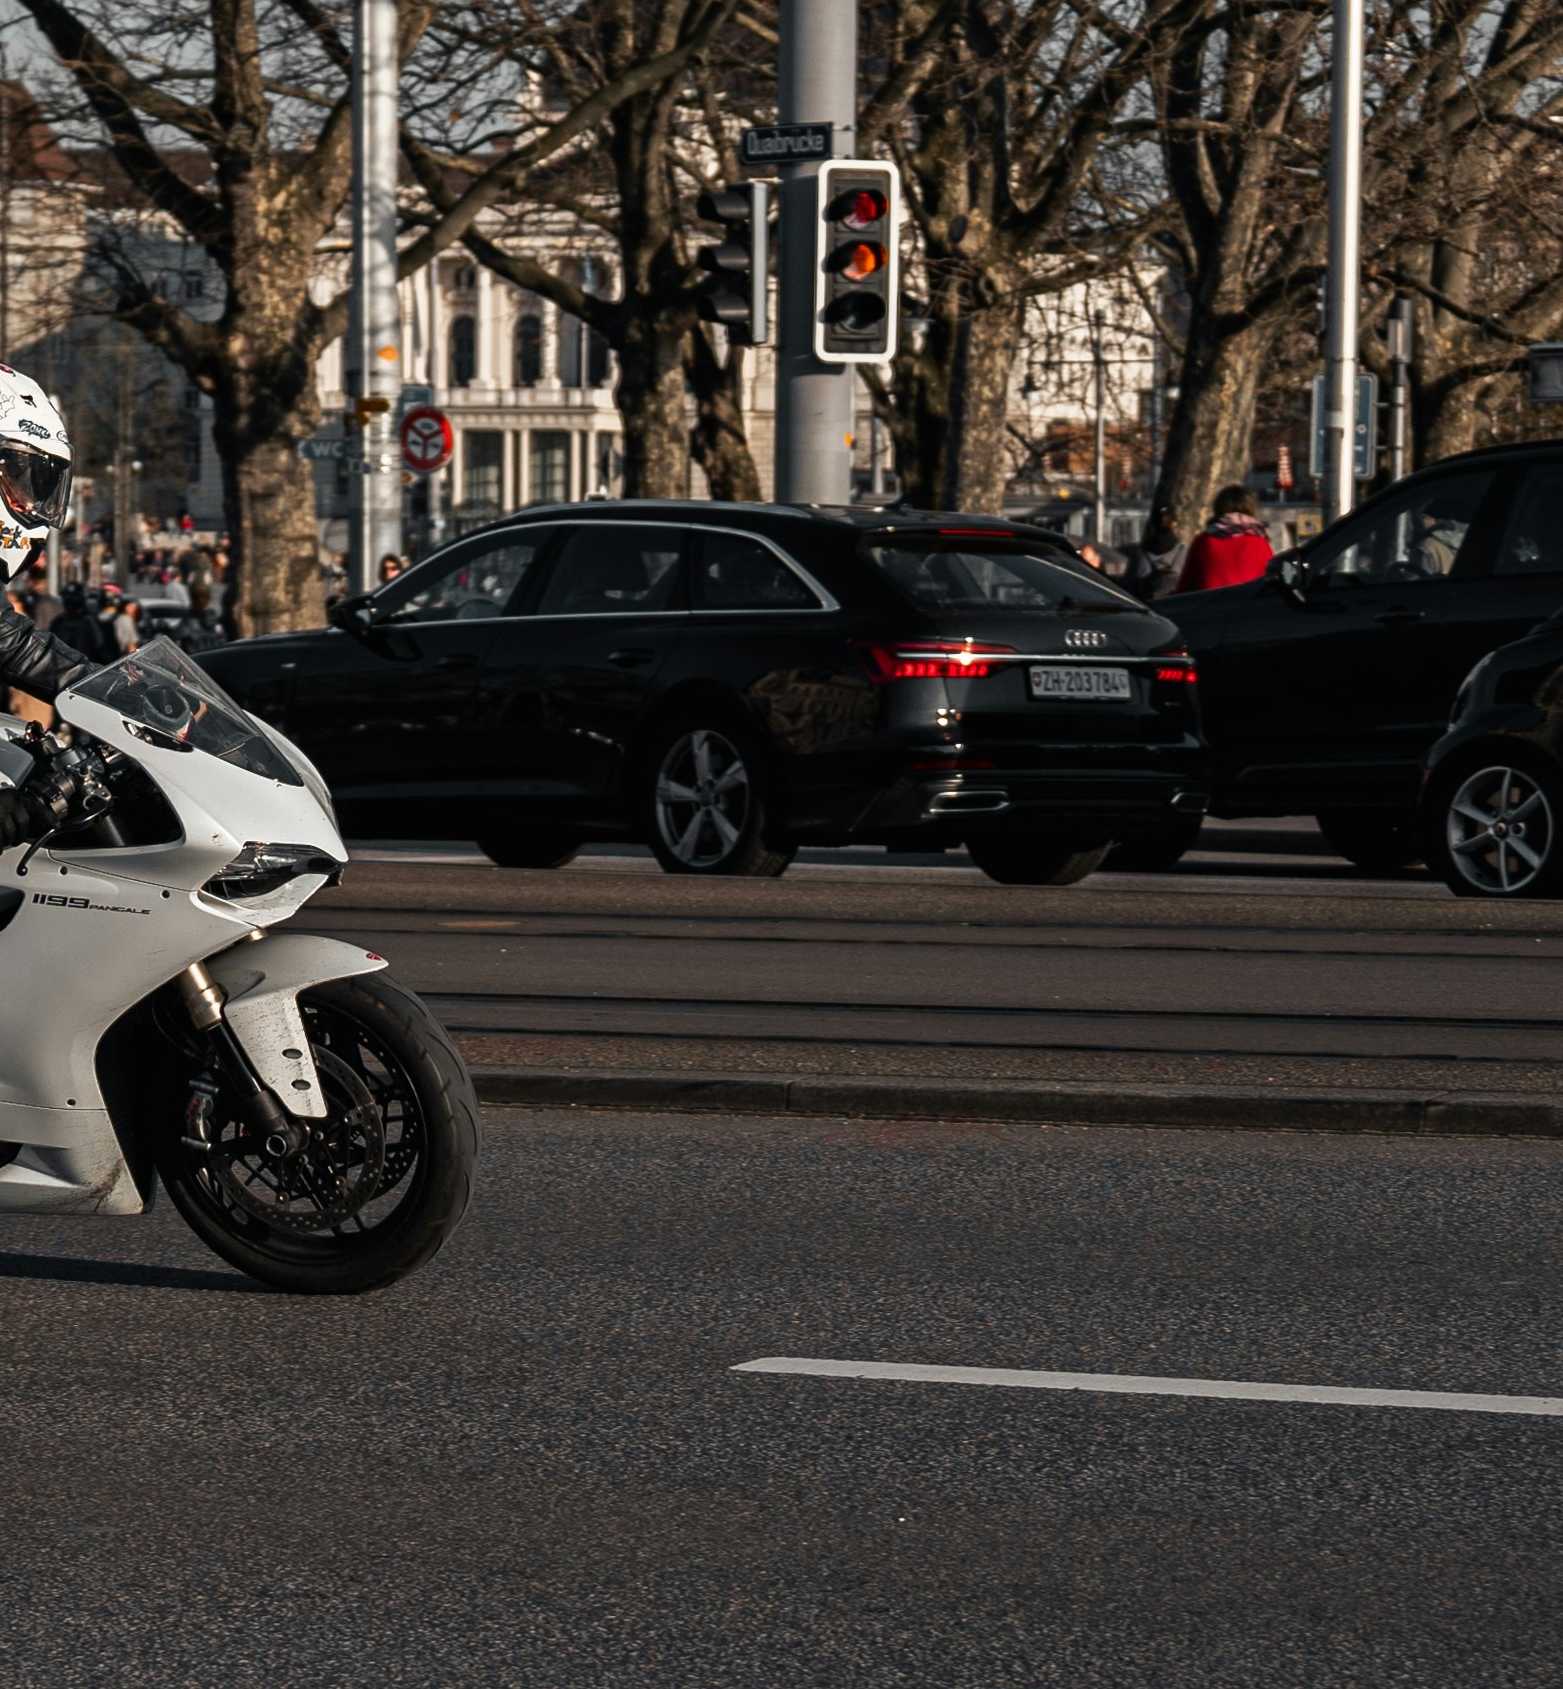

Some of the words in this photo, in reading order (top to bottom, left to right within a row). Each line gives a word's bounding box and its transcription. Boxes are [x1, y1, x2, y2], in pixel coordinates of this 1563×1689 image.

[312, 442, 344, 457] WC
[32, 893, 90, 909] 1199
[89, 904, 151, 915] PANIGALE
